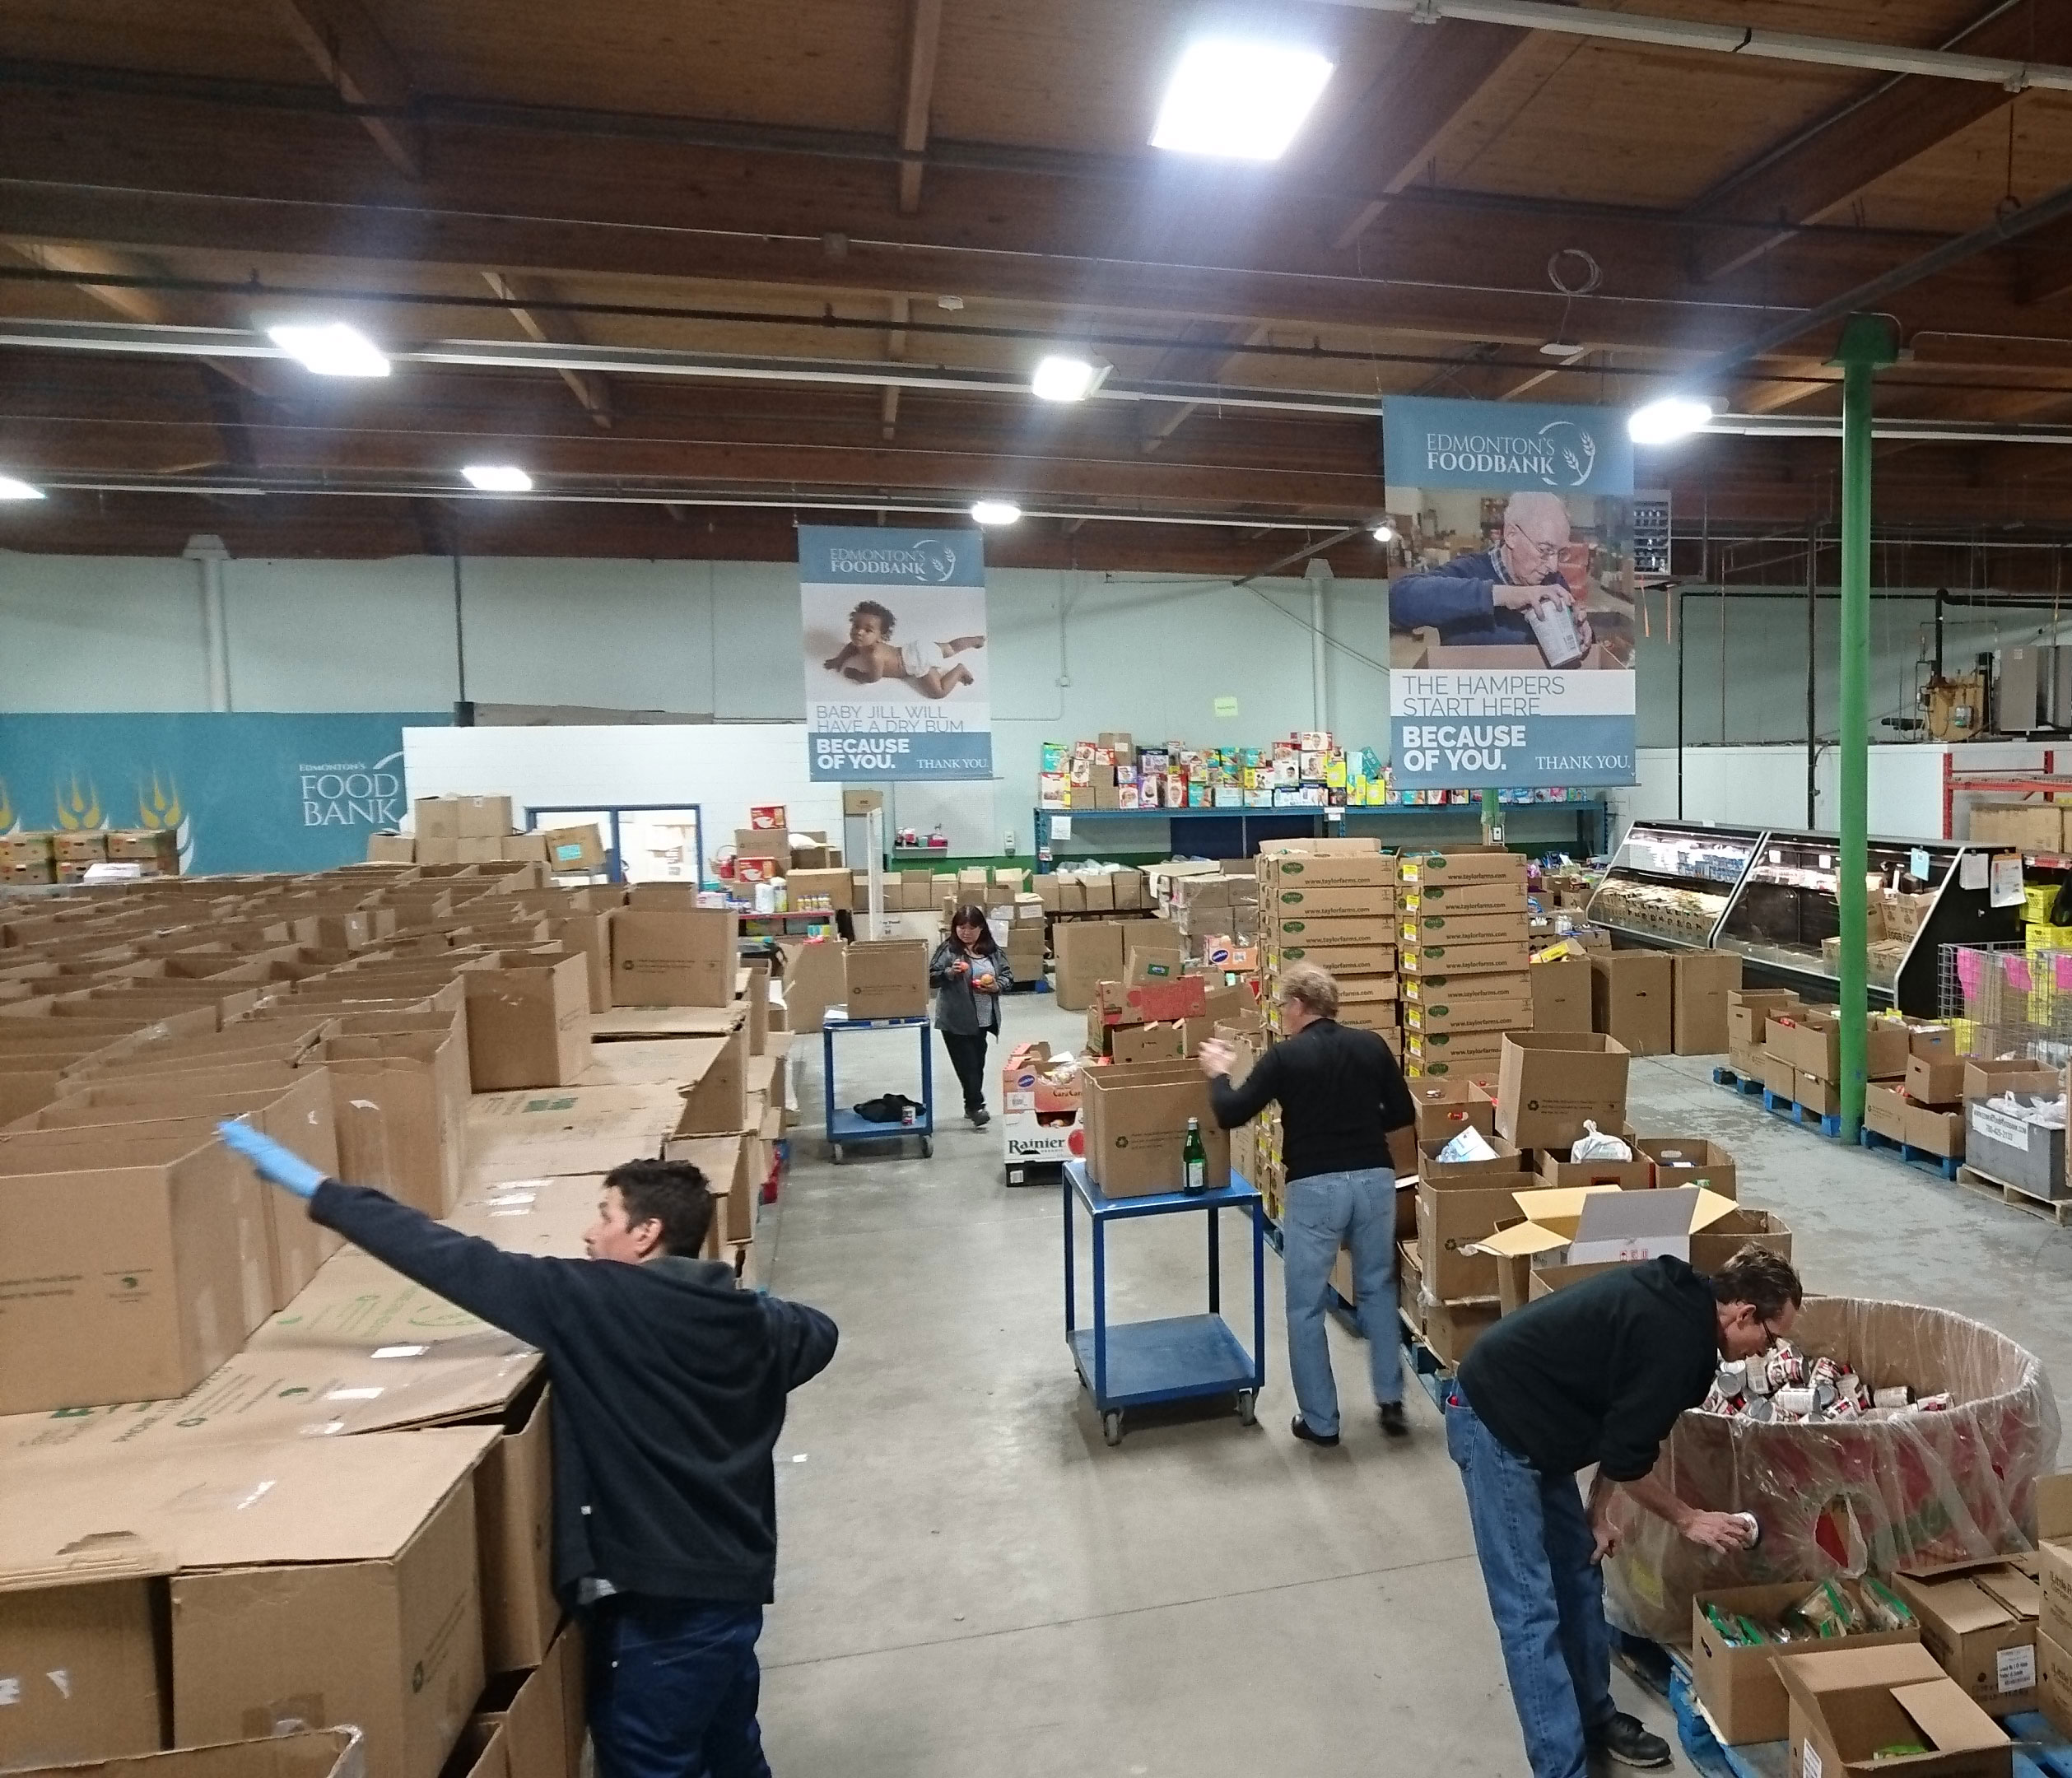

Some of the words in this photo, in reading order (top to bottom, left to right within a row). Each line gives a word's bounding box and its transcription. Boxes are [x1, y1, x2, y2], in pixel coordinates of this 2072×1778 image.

[1427, 432, 1555, 455] EDMONTON'S
[1427, 451, 1555, 475] FOODBANK
[831, 560, 925, 574] FOODBANK
[1402, 676, 1449, 695] THE
[1456, 676, 1565, 696] HAMPERS
[817, 705, 862, 719] BABY
[868, 705, 900, 719] JILL
[906, 705, 948, 719] WILL
[1403, 697, 1474, 716] START
[1483, 697, 1541, 716] HERE
[817, 720, 863, 733] HAVE
[868, 720, 881, 733] A
[886, 720, 920, 733] DRY
[925, 720, 964, 733] BUM
[1402, 725, 1527, 748] BECAUSE
[816, 738, 910, 754] BECAUSE
[817, 755, 845, 769] OF
[848, 754, 896, 769] YOU.
[916, 759, 961, 769] THANK
[1403, 750, 1440, 771] OF
[1445, 749, 1507, 771] YOU.
[1534, 756, 1593, 770] THANK
[1595, 755, 1631, 769] YOU.
[300, 774, 399, 799] FOOD
[302, 798, 399, 826] BANK
[1448, 873, 1506, 881] www.taylorfarms.com
[1446, 932, 1507, 940] www.taylorfarms.com
[1446, 960, 1507, 969] www.taylorfarms.com
[1450, 1018, 1512, 1027] www.taylorfarms.com
[1450, 1047, 1502, 1055] www.taylorfarms.
[1008, 1138, 1065, 1155] Rainier
